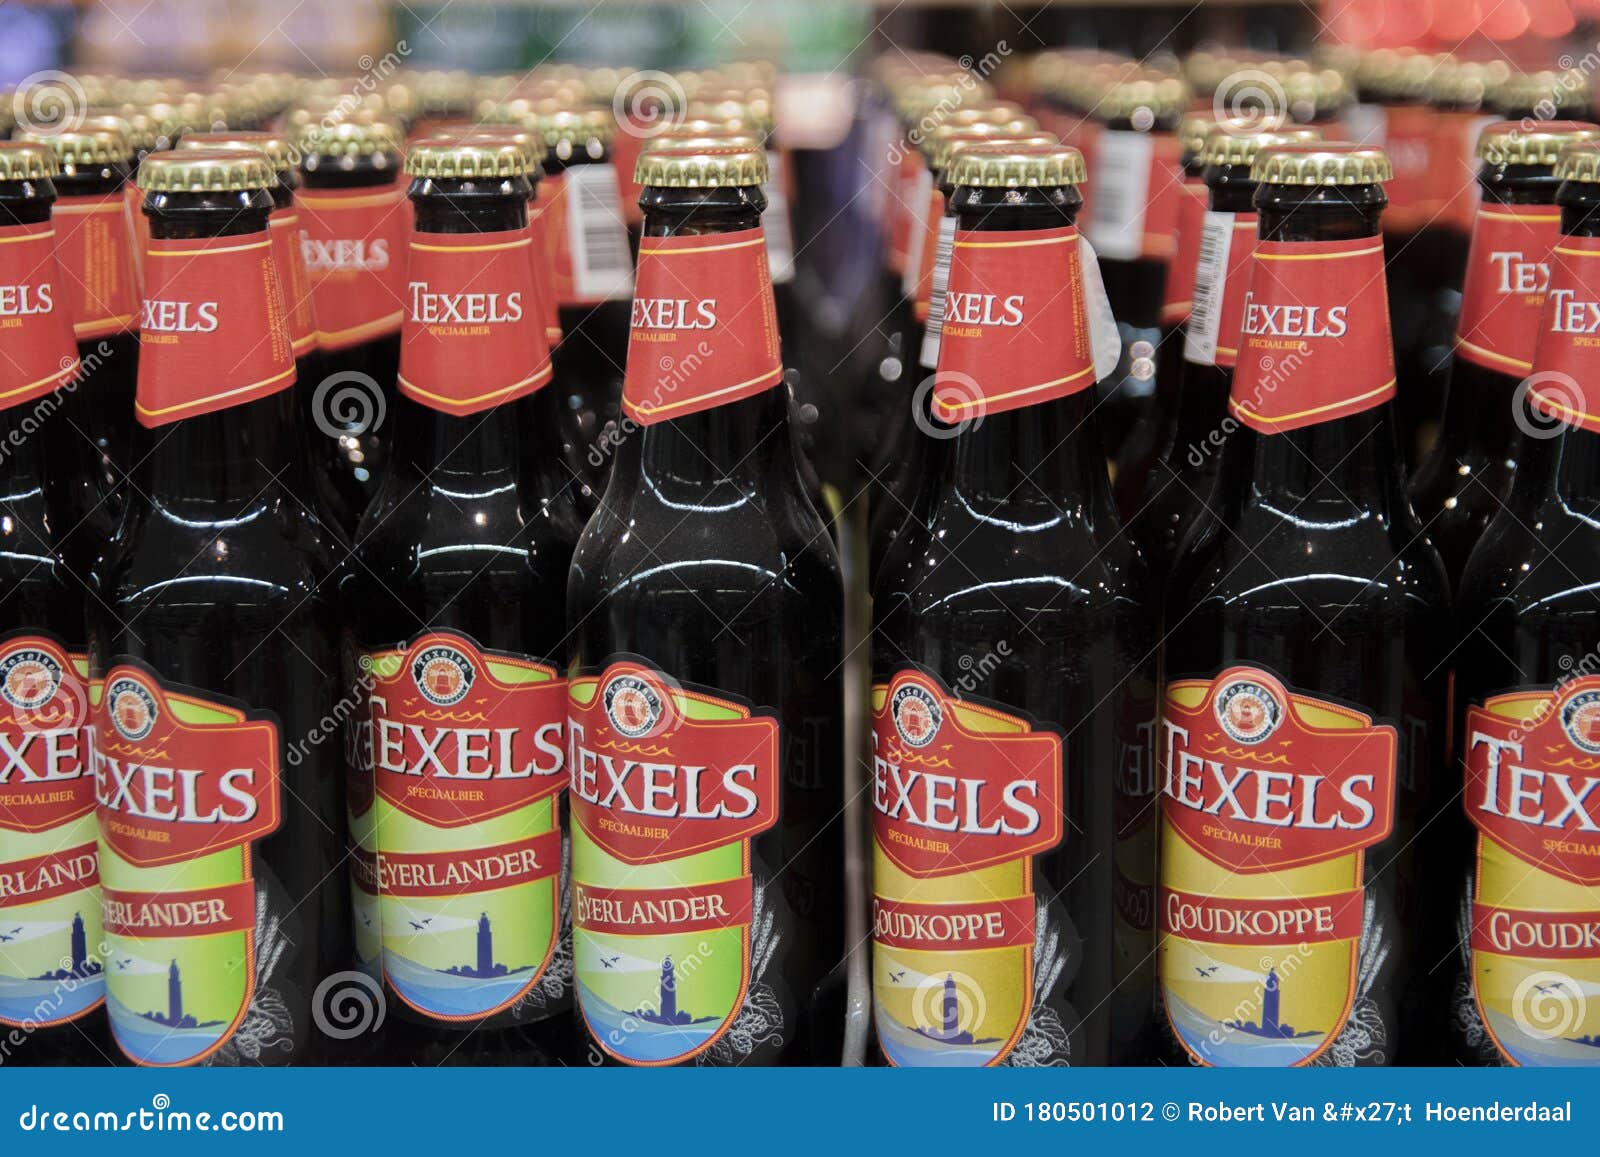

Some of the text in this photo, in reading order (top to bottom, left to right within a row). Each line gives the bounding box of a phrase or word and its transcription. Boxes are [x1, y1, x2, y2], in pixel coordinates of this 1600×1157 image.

[408, 281, 523, 323] TEXELS
[567, 716, 760, 820] TEXELS
[1160, 717, 1377, 831] TEXELS
[406, 784, 486, 803] SPECIAALBIER
[598, 817, 671, 841] SPECIAALBIER
[887, 828, 951, 854] SPECIAALBIER
[1202, 823, 1282, 850] SPECIAALBIER
[376, 848, 543, 890] EYERLANDER
[576, 886, 730, 925] EYERLANDER
[1167, 893, 1335, 936] GOUDKOPPE
